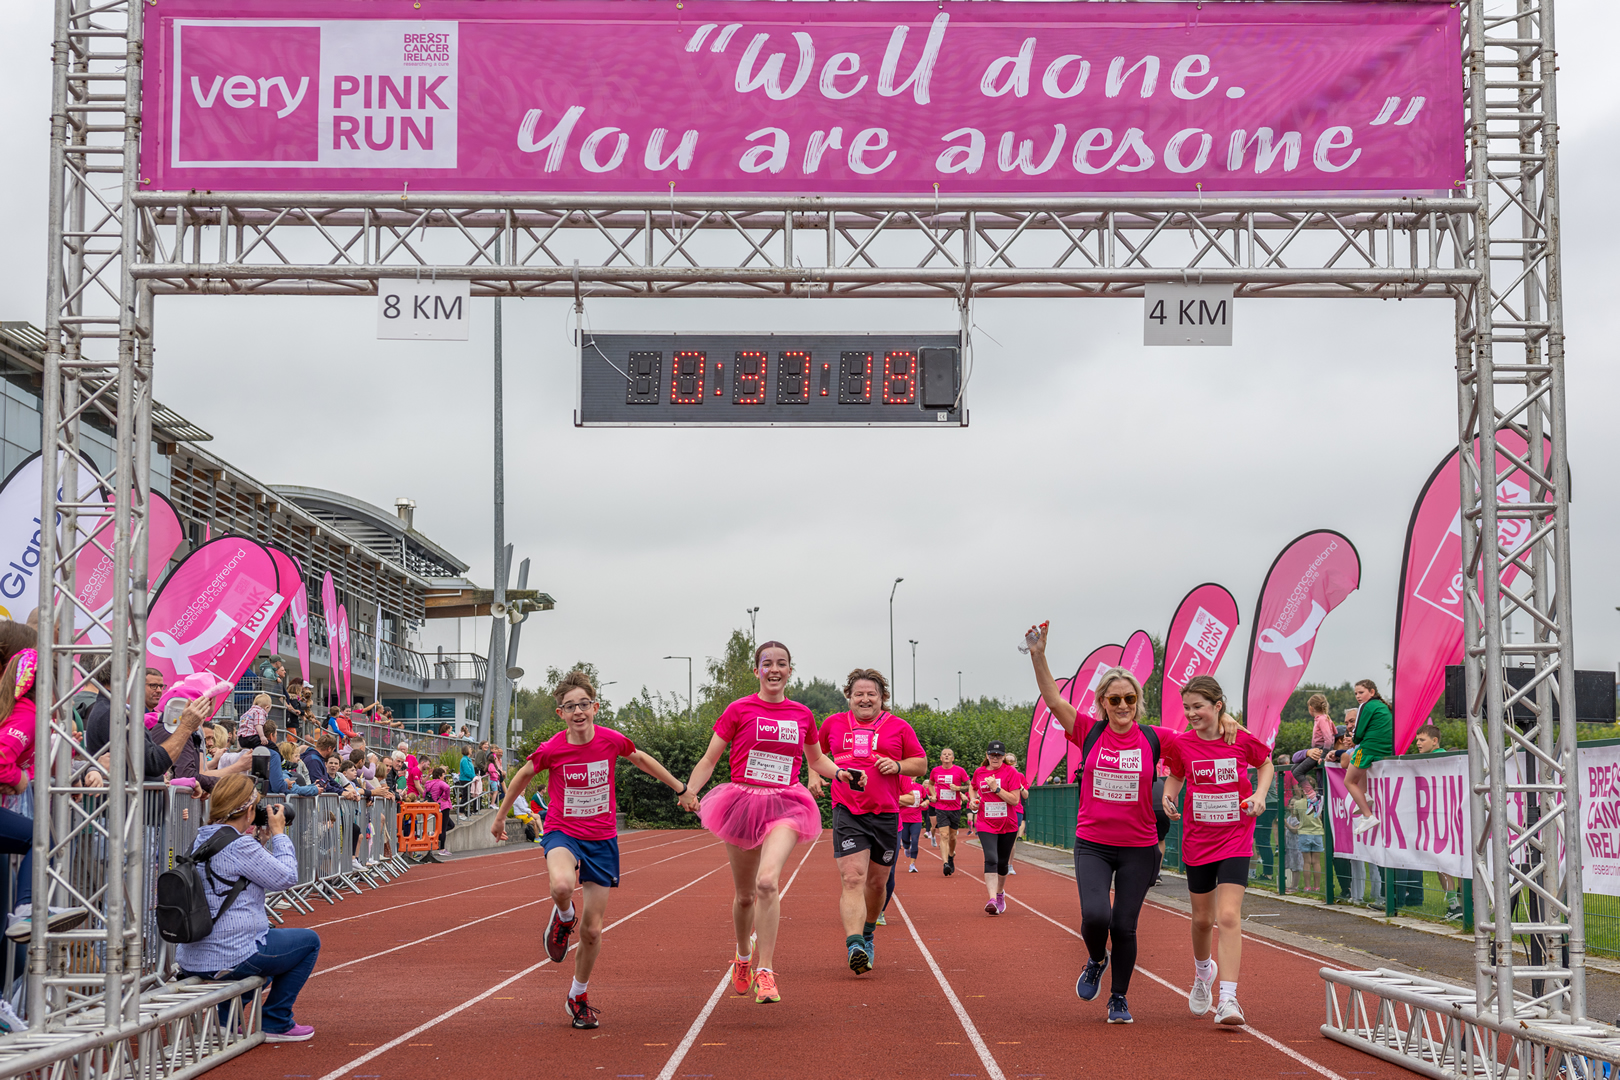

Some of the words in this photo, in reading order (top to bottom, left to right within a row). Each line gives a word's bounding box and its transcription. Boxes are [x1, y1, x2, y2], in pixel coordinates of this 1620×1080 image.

[404, 44, 449, 53] CANCER
[404, 53, 449, 61] IRELAND
[980, 37, 1246, 99] done.
[190, 75, 310, 119] very
[333, 75, 449, 109] PINK
[333, 116, 433, 151] RUN
[517, 105, 699, 174] You
[738, 126, 897, 175] are
[383, 294, 401, 319] 8
[413, 295, 463, 320] KM
[1149, 299, 1168, 325] 4
[1179, 299, 1227, 325] KM
[671, 351, 916, 404] 0:37:18
[167, 547, 247, 636] breastcancerireland
[1273, 540, 1338, 630] breastcancerireland
[175, 584, 210, 640] researching
[213, 580, 228, 597] cure
[244, 598, 275, 633] RUN
[1281, 592, 1307, 633] researching
[1307, 571, 1320, 587] cure
[1197, 618, 1216, 651] PINK
[1205, 627, 1223, 656] RUN
[1180, 651, 1201, 684] very
[759, 725, 778, 734] very
[781, 726, 798, 735] PINK
[781, 733, 796, 741] RUN
[1100, 753, 1120, 764] very
[1217, 767, 1236, 775] PINK
[566, 772, 587, 781] very
[590, 769, 608, 778] PINK
[590, 776, 606, 785] RUN
[760, 772, 776, 780] 7552
[1194, 768, 1214, 777] very
[1217, 774, 1235, 782] RUN
[1415, 775, 1464, 856] RUN
